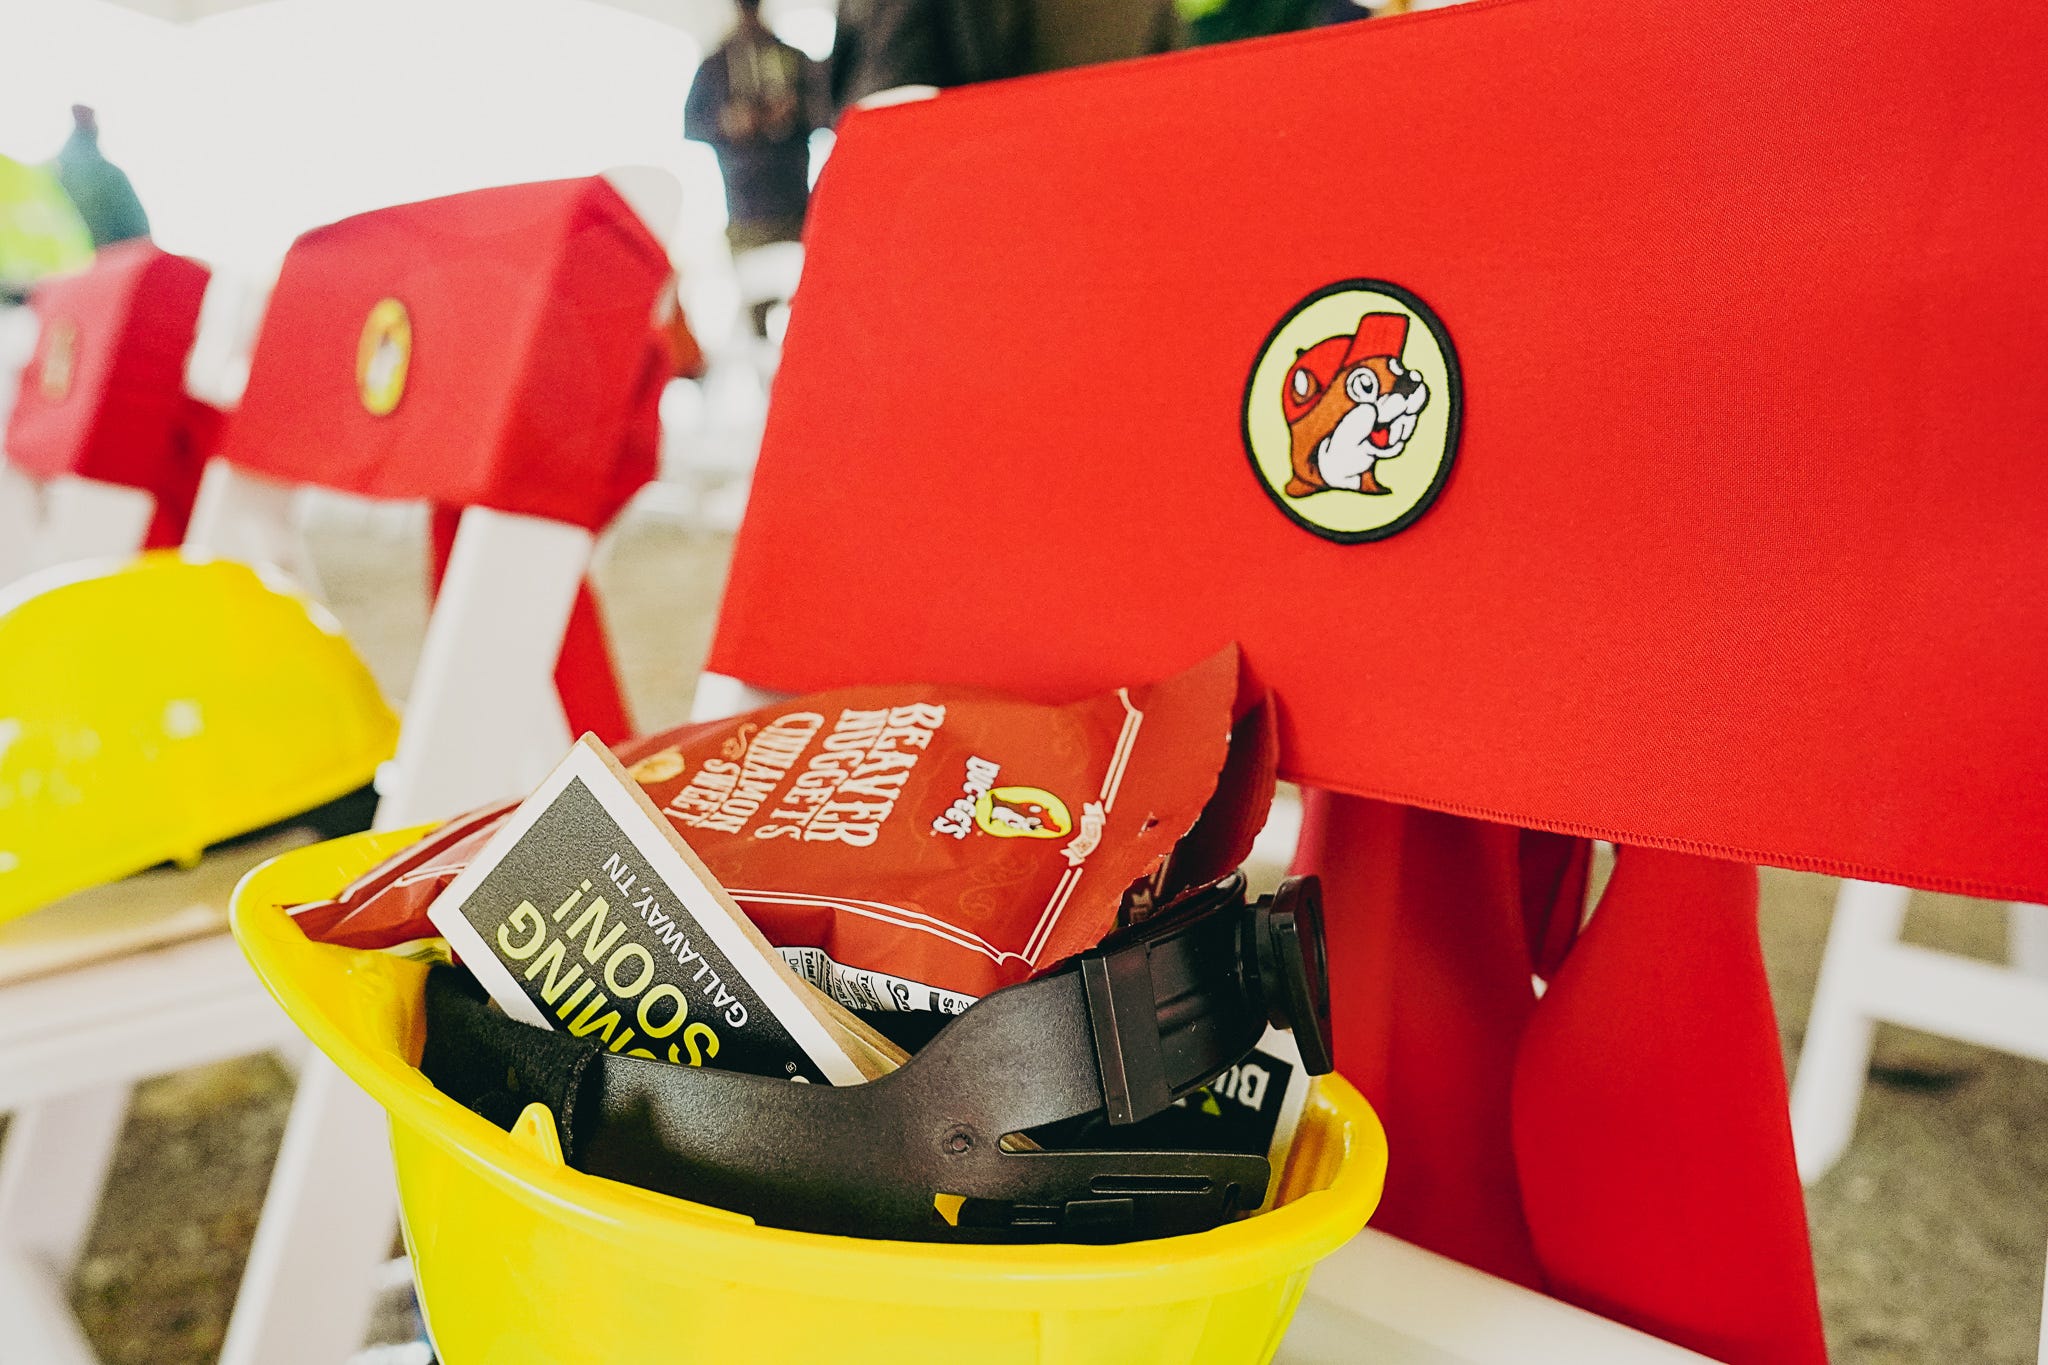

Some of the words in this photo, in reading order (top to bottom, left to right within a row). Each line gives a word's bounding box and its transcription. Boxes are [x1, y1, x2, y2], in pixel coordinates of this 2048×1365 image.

[662, 758, 741, 827] SWEET
[696, 711, 825, 834] CINNAMON
[754, 708, 890, 841] NUGGETS
[804, 702, 946, 847] BEAVER
[601, 852, 637, 898] TN
[497, 899, 657, 1060] MING
[552, 878, 720, 1067] SOON!
[632, 887, 748, 1028] GALLAWAY,
